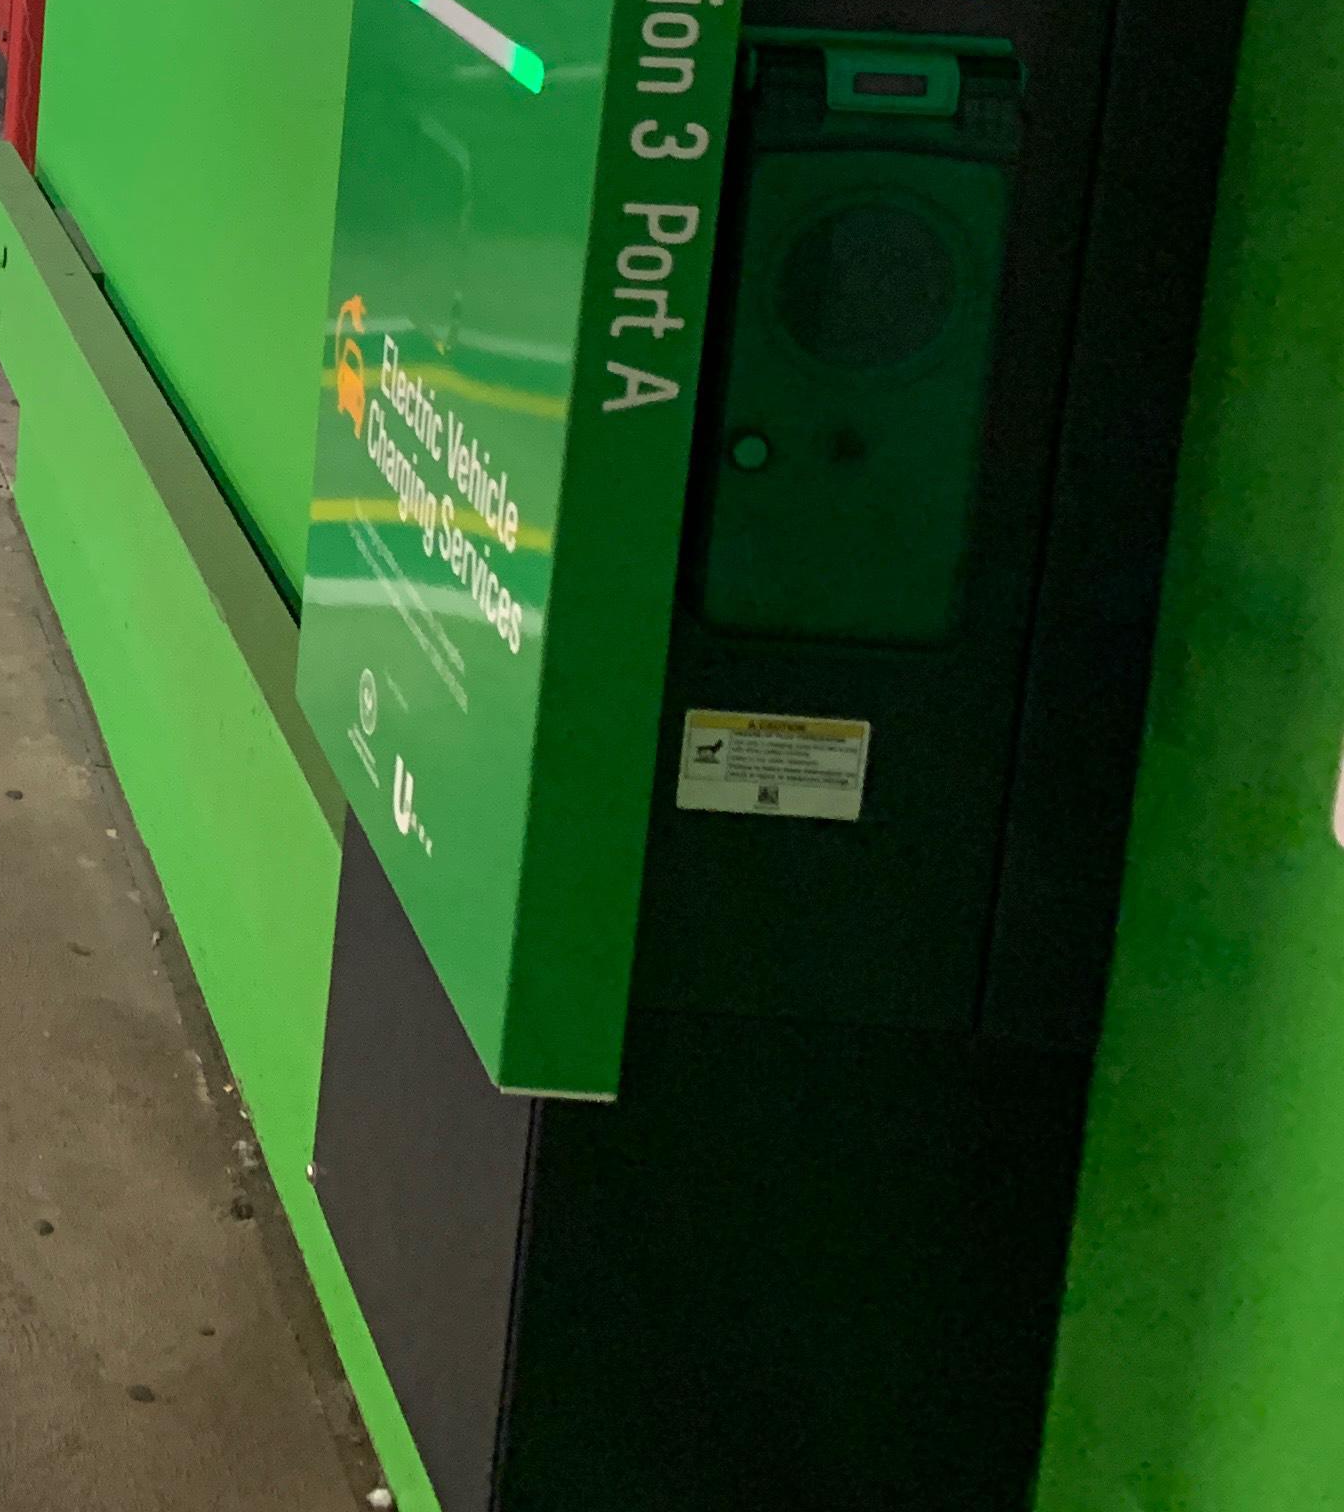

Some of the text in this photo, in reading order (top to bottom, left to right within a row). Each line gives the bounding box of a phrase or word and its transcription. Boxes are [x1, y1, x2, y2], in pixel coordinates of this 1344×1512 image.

[630, 119, 710, 160] 3
[610, 203, 700, 339] Port
[381, 333, 443, 462] Electric
[447, 409, 518, 554] Vehicle
[602, 361, 680, 412] A
[368, 398, 437, 558] Charging
[439, 494, 522, 655] Services
